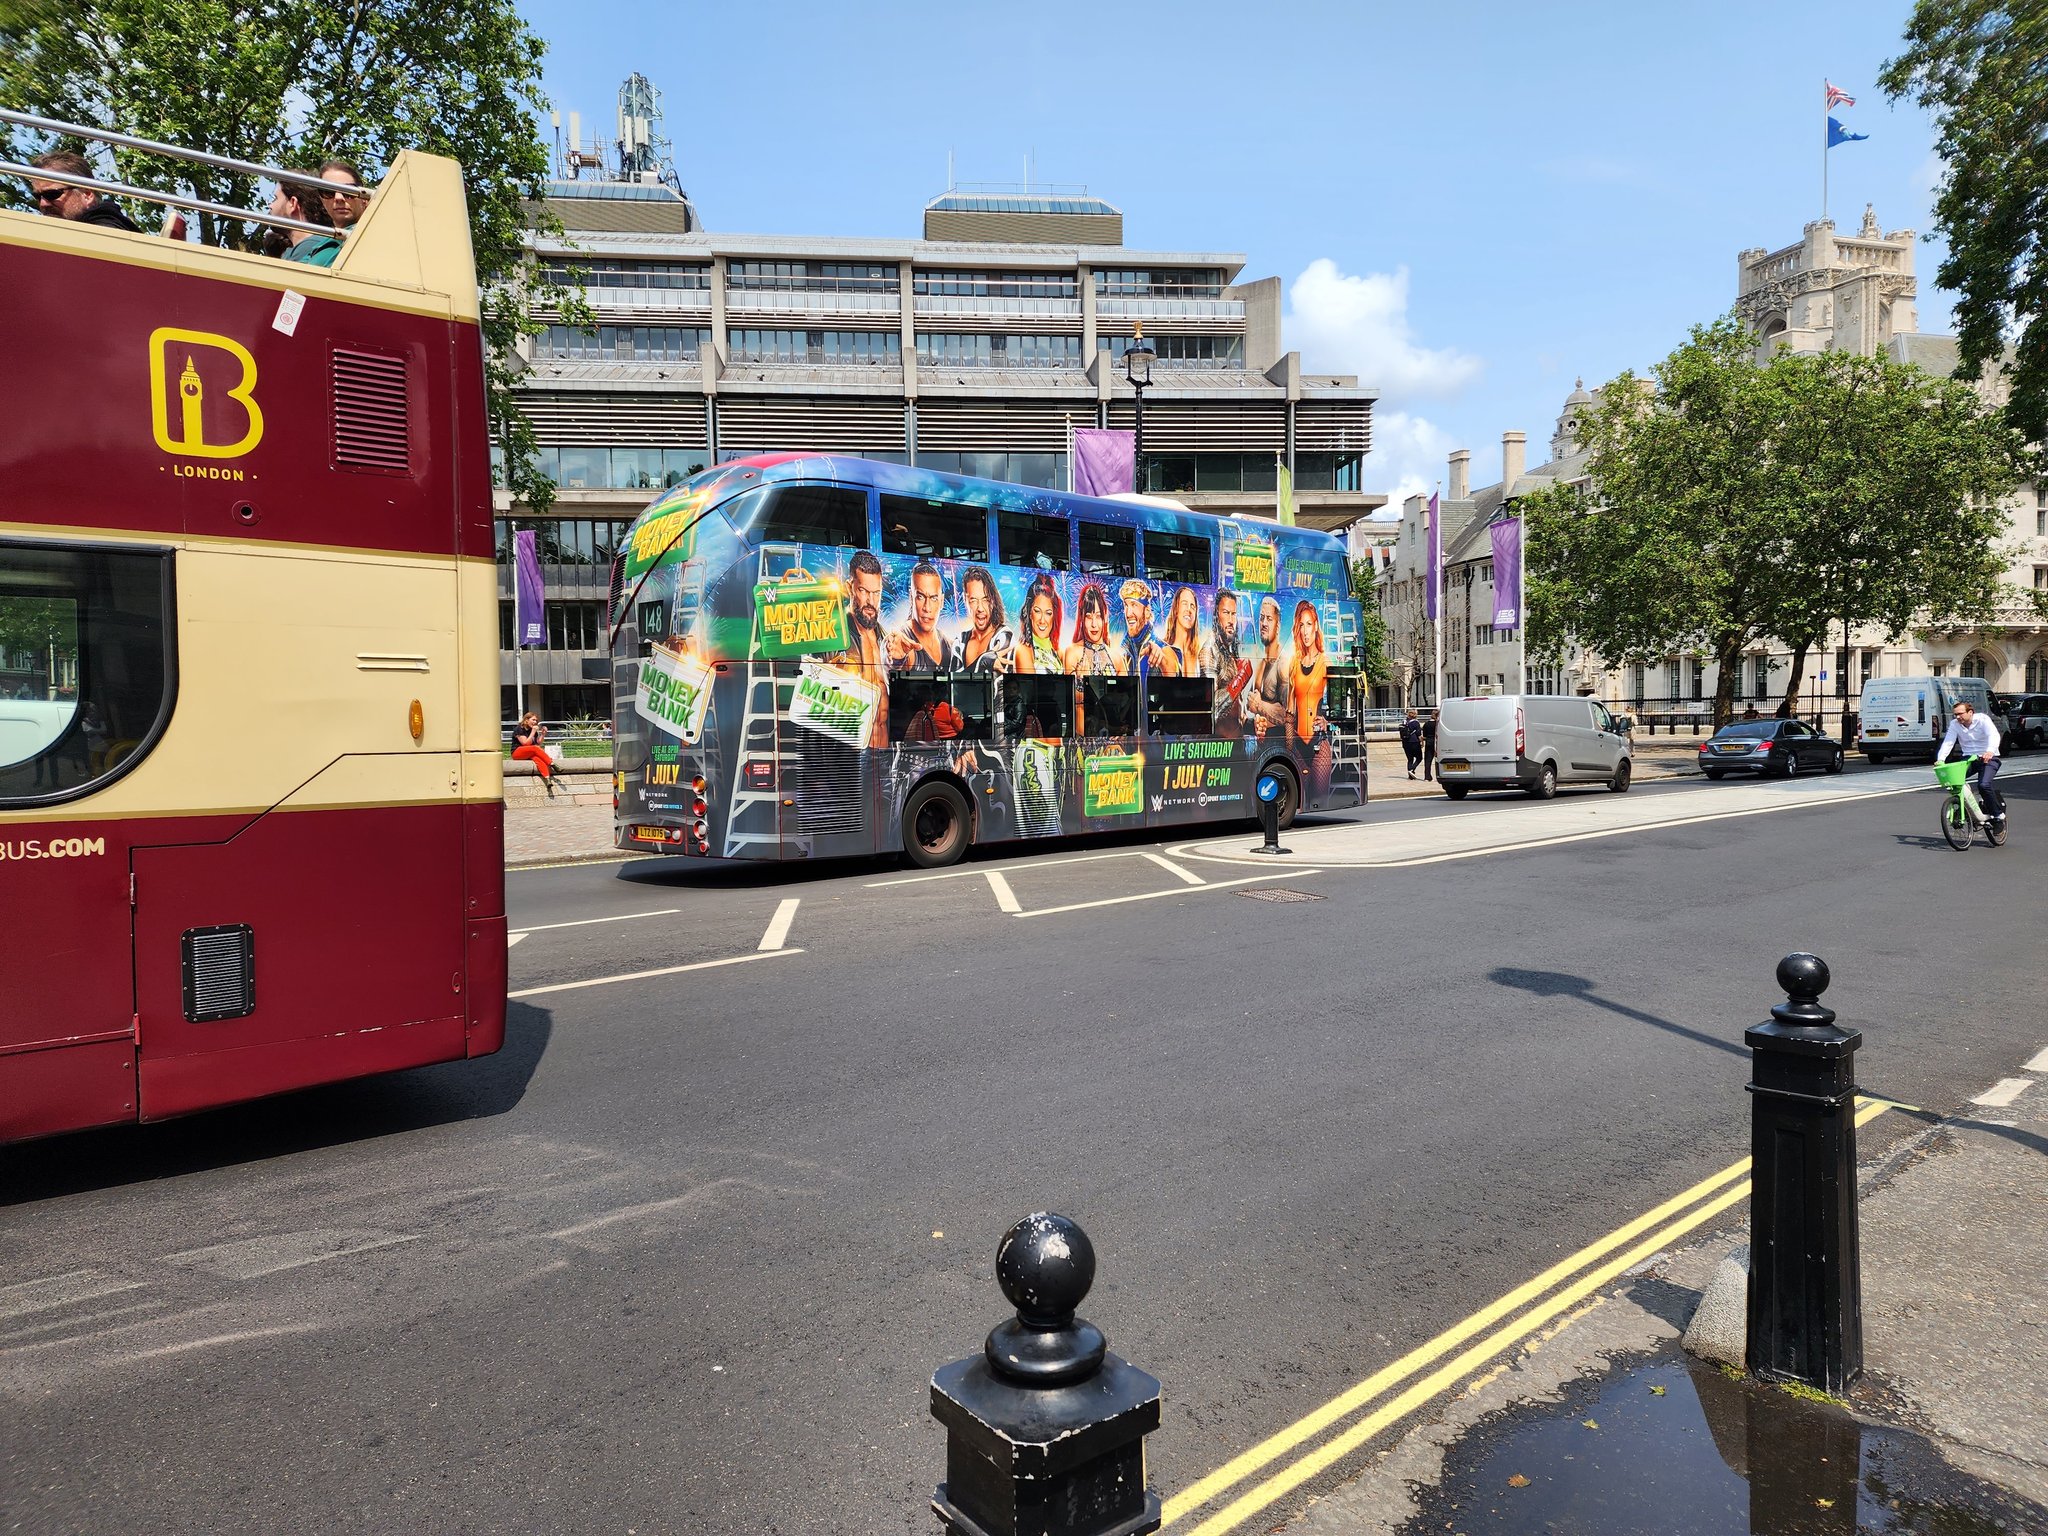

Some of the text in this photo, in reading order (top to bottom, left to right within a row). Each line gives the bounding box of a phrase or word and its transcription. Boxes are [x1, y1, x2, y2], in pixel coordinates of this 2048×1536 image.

[173, 464, 244, 482] LONDON
[631, 508, 697, 547] MONEY
[1236, 555, 1272, 572] MONEY
[1285, 557, 1333, 575] LIVE SATURDAY
[1242, 570, 1271, 585] BANK
[1287, 572, 1292, 587] 1
[1293, 572, 1313, 589] JULY
[644, 605, 662, 634] 148
[763, 600, 838, 626] MONEY
[780, 619, 839, 645] BANK
[641, 662, 702, 707] MONEY
[800, 676, 870, 717] MONEY
[646, 689, 695, 730] BANK
[655, 754, 677, 762] SATURDAY
[1164, 741, 1234, 760] LIVE SATURDAY
[646, 764, 651, 785] 1
[652, 764, 680, 785] JULY
[1088, 771, 1138, 790] MONEY
[1163, 764, 1231, 790] 1 JULY 8PM
[1097, 788, 1137, 807] BANK
[1163, 797, 1195, 806] NETWORK
